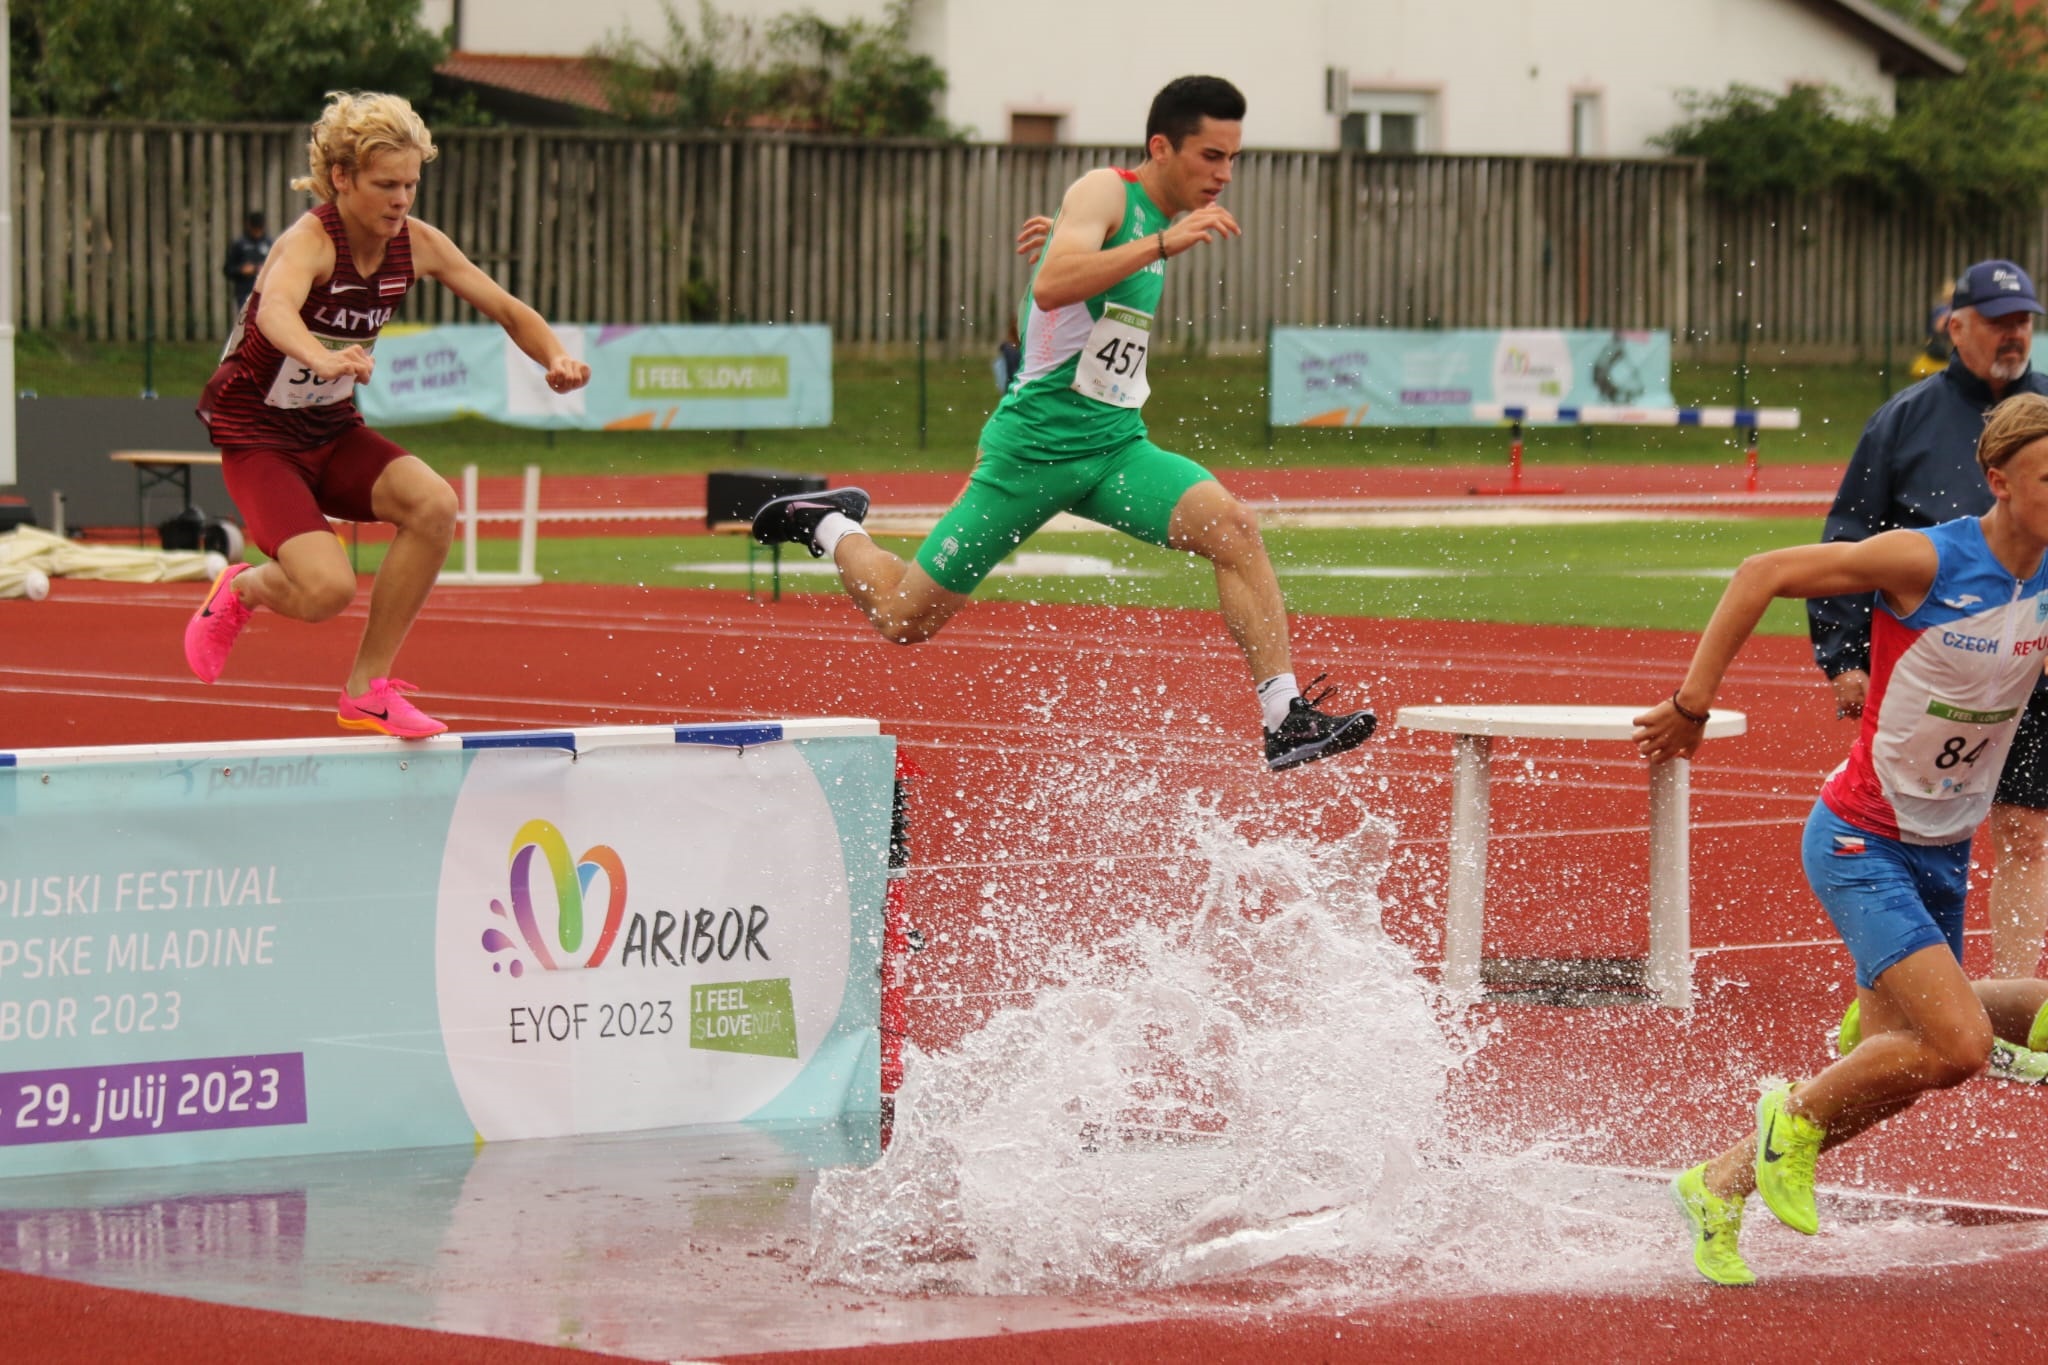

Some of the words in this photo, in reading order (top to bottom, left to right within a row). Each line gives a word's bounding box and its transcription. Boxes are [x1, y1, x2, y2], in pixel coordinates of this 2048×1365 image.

[314, 306, 392, 331] LATVIA
[1096, 337, 1146, 380] 457
[650, 367, 692, 389] FEEL
[1943, 630, 1999, 655] CZECH
[1953, 711, 1974, 721] FEEL
[1935, 736, 1990, 769] 84
[207, 756, 323, 797] polanik
[115, 865, 282, 912] FESTIVAL
[106, 925, 277, 974] MLADINE
[90, 990, 182, 1036] 2023
[695, 991, 703, 1013] I
[707, 987, 749, 1012] FEEL
[510, 1003, 590, 1044] EYOF
[600, 1000, 674, 1038] 2023
[695, 1010, 782, 1040] SLOVENIA
[15, 1082, 82, 1129] 29.
[89, 1073, 167, 1133] julij
[177, 1068, 281, 1116] 2023
